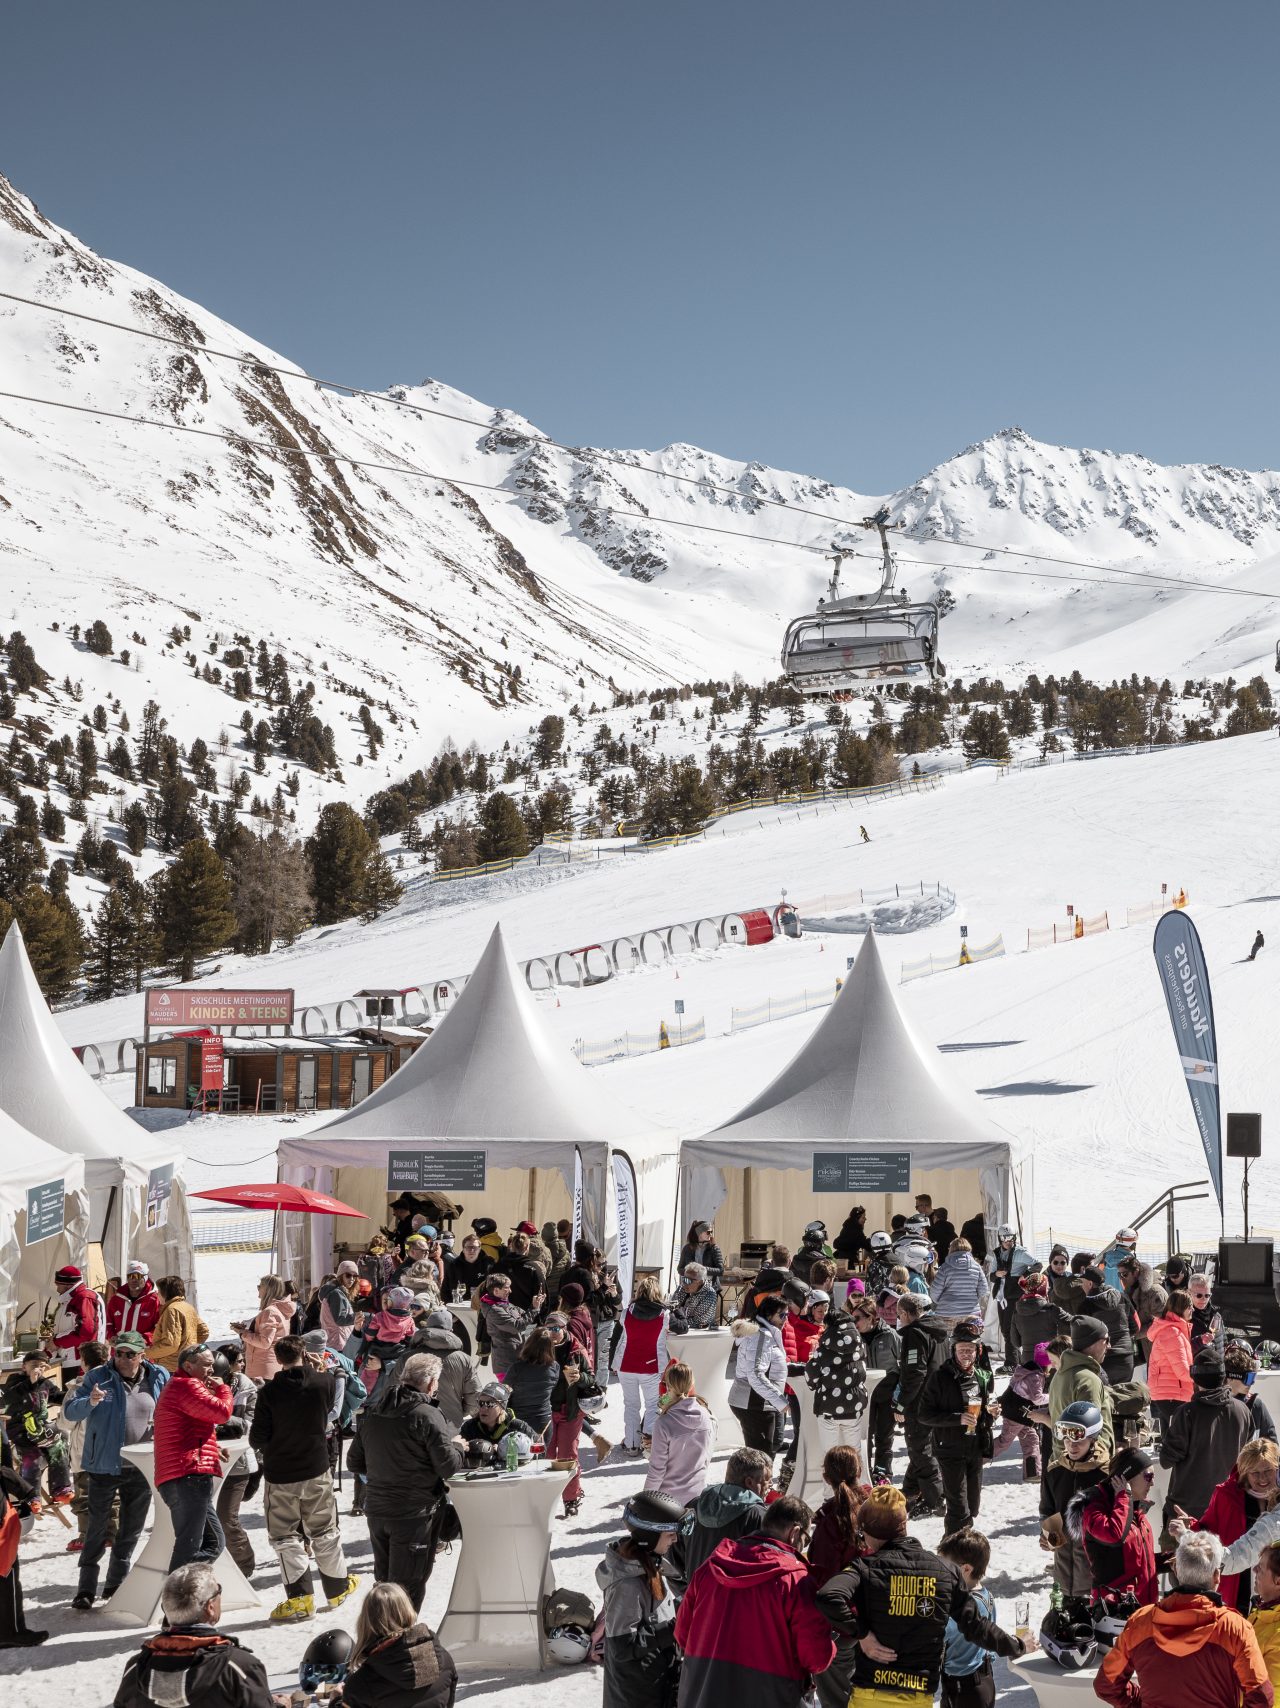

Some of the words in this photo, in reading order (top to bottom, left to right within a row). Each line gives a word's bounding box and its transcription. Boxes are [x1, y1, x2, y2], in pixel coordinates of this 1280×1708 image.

[191, 996, 232, 1005] SKISCHULE
[233, 996, 287, 1005] MEETINGPOINT
[189, 1007, 235, 1019] KINDER
[238, 1007, 247, 1019] &
[251, 1007, 287, 1019] TEENS
[890, 1575, 937, 1597] NAUDERS
[888, 1596, 916, 1616] 3000
[873, 1669, 928, 1691] SKISCHULE
